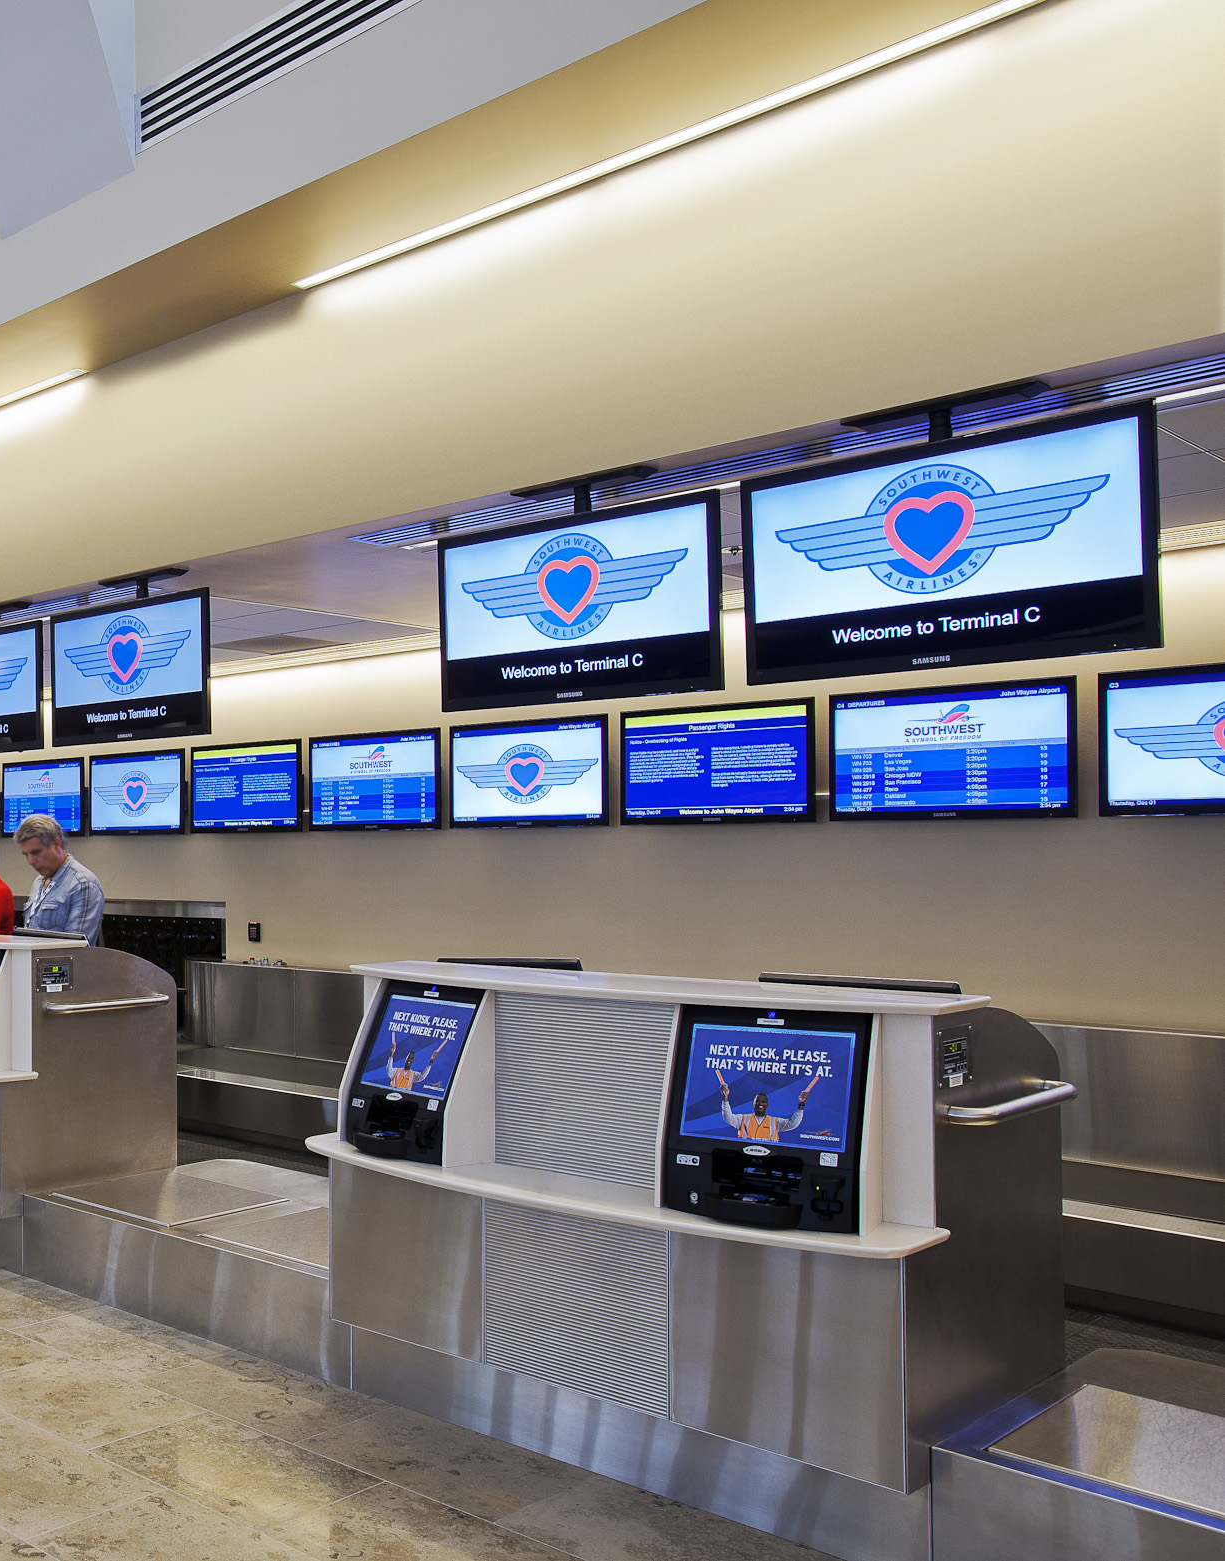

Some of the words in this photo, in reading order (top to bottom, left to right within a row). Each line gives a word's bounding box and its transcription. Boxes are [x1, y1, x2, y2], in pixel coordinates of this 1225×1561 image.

[877, 468, 982, 507] SOUTHWEST
[533, 536, 605, 567] SOUTHWEST
[105, 617, 146, 640] SOUTHWEST
[831, 619, 913, 646] Welcome
[916, 618, 935, 636] to
[938, 608, 1019, 633] Terminal
[1023, 606, 1041, 624] C
[501, 662, 557, 680] Welcome
[559, 661, 572, 675] to
[574, 654, 629, 673] Terminal
[632, 653, 644, 667] C
[911, 654, 951, 666] SAMSUNG
[556, 690, 583, 699] SAMSUNG
[999, 690, 1016, 698] John
[1016, 688, 1038, 697] Wayne
[1038, 687, 1061, 696] Airport
[847, 699, 886, 709] DEPARTURES
[86, 711, 118, 725] Welcome
[119, 710, 127, 721] to
[128, 706, 159, 720] Terminal
[160, 705, 167, 718] C
[3, 723, 9, 734] C
[688, 723, 717, 733] Passenger
[904, 723, 984, 737] SOUTHWEST
[503, 746, 548, 762] SOUTHWEST
[349, 760, 392, 770] SOUTHWEST
[679, 808, 703, 816] Welcome
[725, 808, 743, 816] Wayne
[743, 807, 764, 816] Airport
[393, 1010, 411, 1022] NEXT
[409, 1013, 431, 1027] KIOSK,
[431, 1016, 459, 1030] PLEASE.
[387, 1021, 411, 1034] THAT'S
[409, 1024, 433, 1038] WHERE
[432, 1028, 447, 1040] IT'S
[445, 1030, 457, 1041] AT.
[709, 1043, 740, 1057] NEXT
[741, 1046, 780, 1061] KIOSK,
[782, 1048, 832, 1064] PLEASE.
[705, 1057, 745, 1072] THAT'S
[747, 1060, 788, 1075] WHERE
[789, 1063, 813, 1077] IT'S
[815, 1066, 833, 1078] AT.
[799, 1133, 841, 1142] SOUTHWEST.COM
